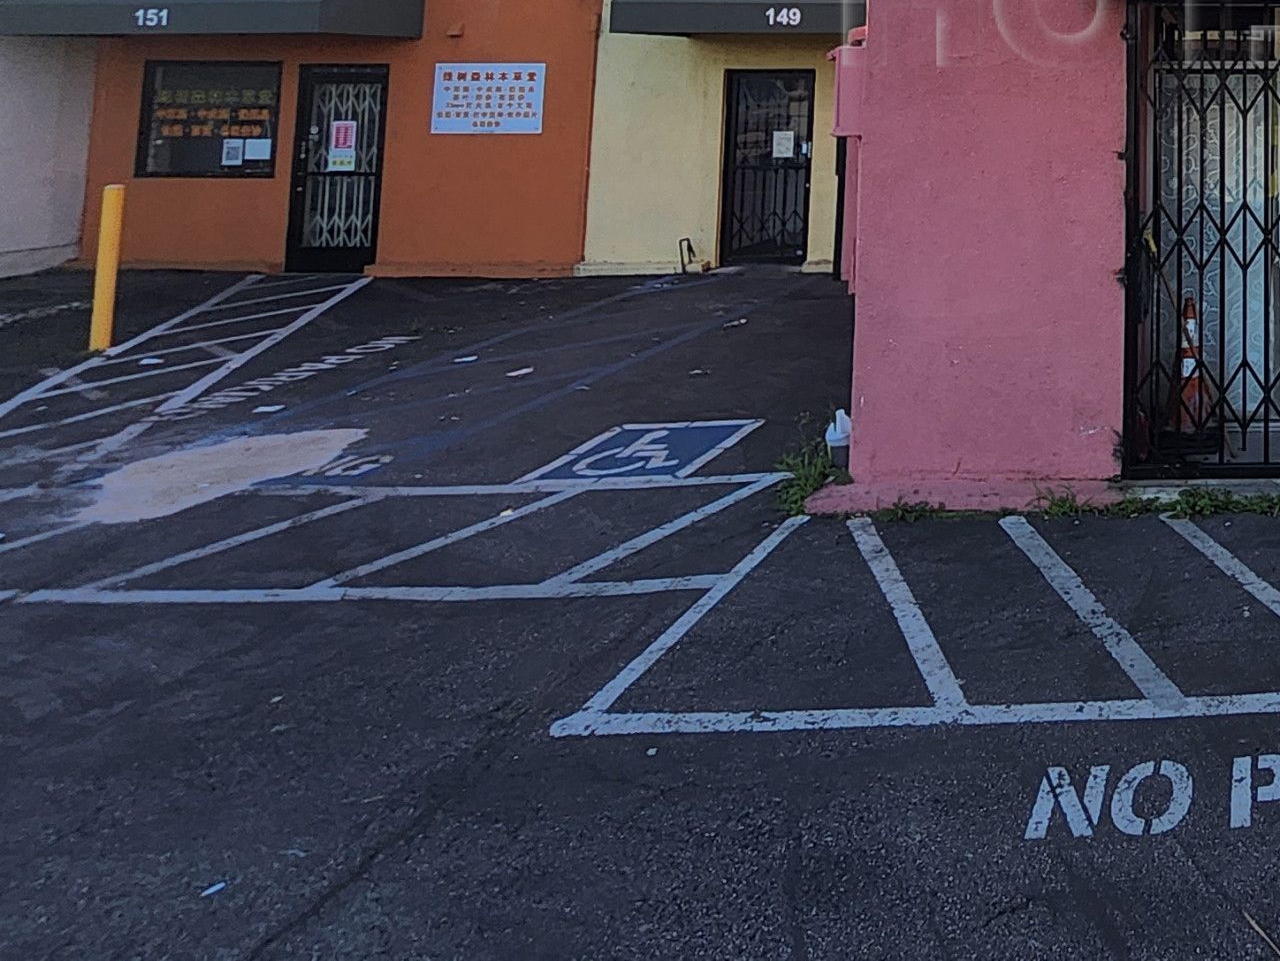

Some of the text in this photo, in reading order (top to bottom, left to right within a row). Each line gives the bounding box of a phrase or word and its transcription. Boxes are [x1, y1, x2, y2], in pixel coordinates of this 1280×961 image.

[134, 8, 169, 26] 151
[765, 7, 802, 26] 149
[1024, 759, 1194, 839] NO
